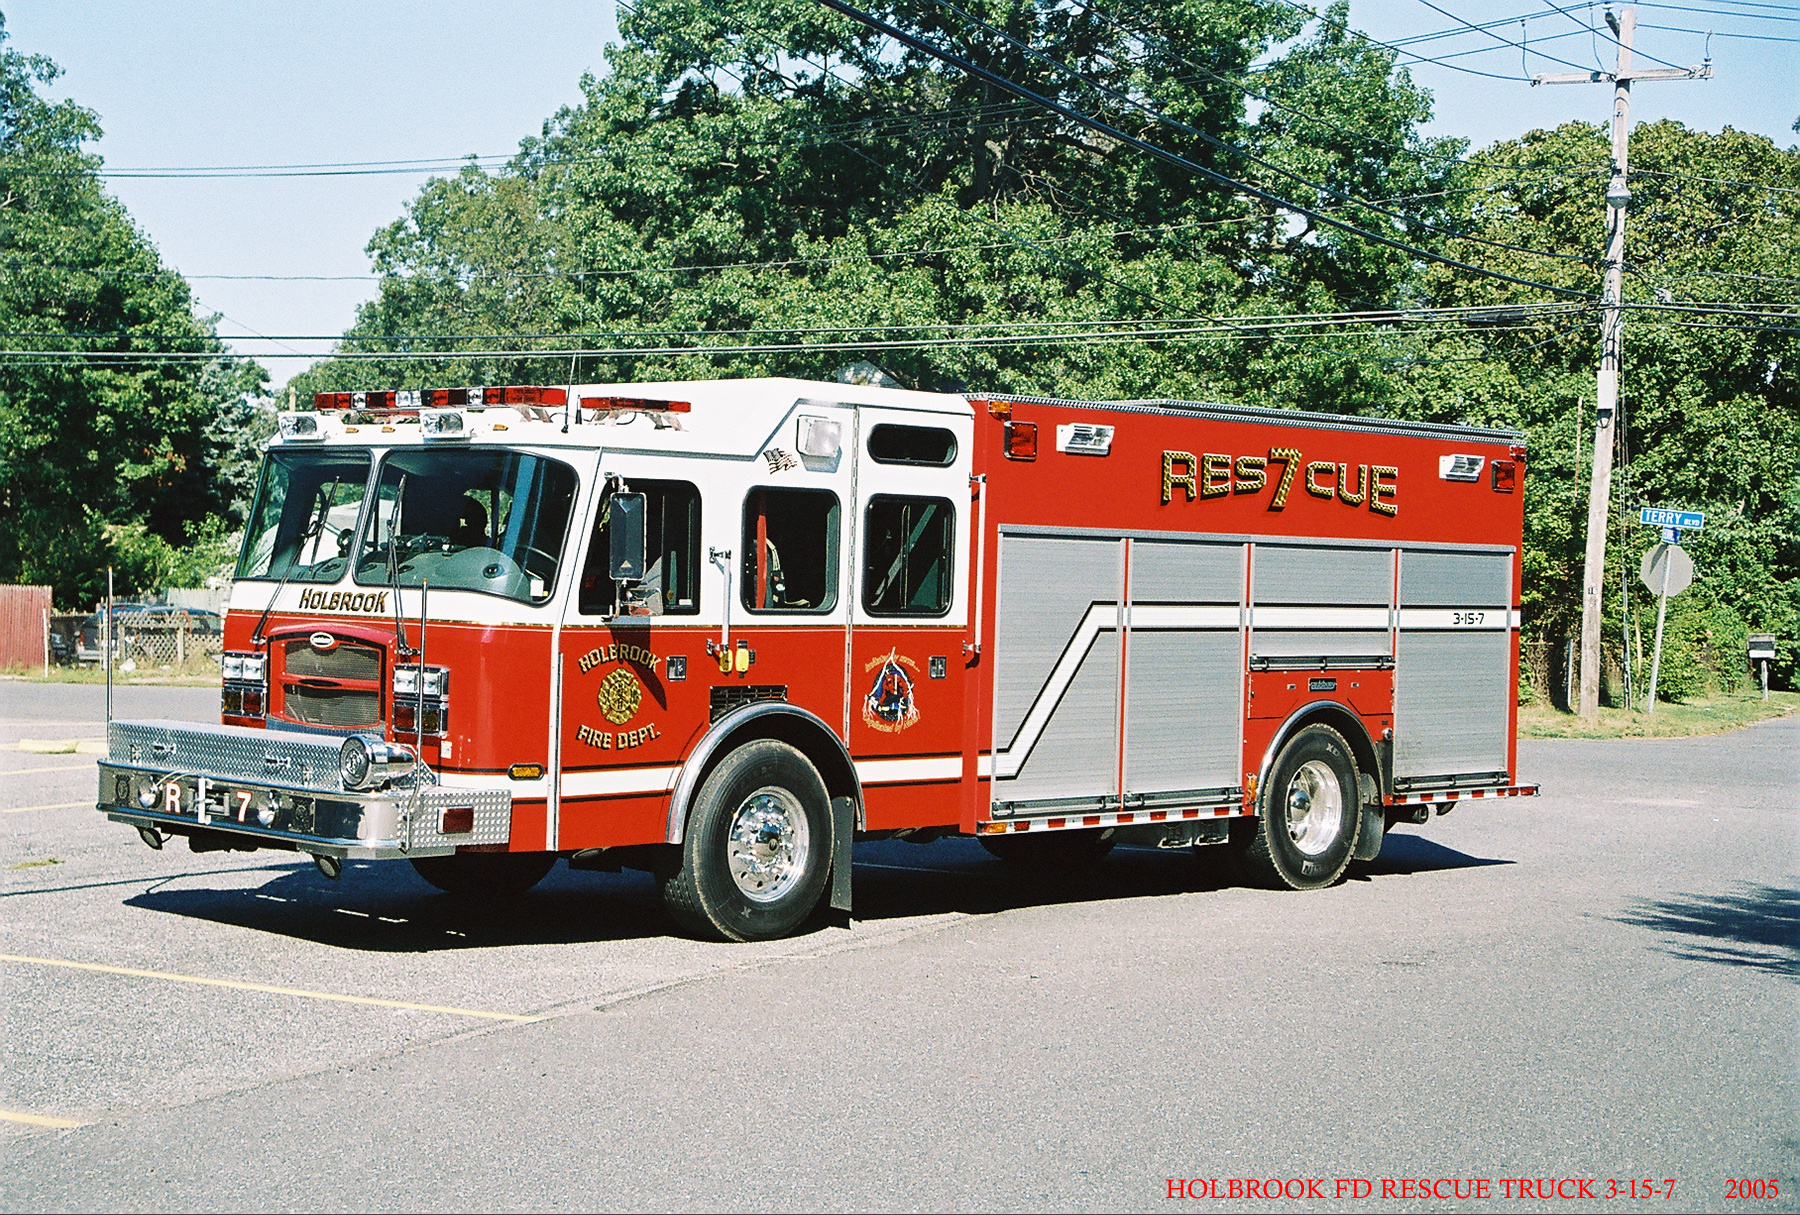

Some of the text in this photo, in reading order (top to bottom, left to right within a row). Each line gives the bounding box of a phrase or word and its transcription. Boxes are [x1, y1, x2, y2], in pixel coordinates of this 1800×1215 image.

[1645, 510, 1700, 526] TERRY BLVD
[299, 588, 389, 613] HOLBROOK
[1453, 612, 1485, 625] 3-15-7
[578, 643, 661, 674] HOLBROOK
[576, 722, 661, 750] FIRE DEPT.
[164, 781, 252, 823] R 7
